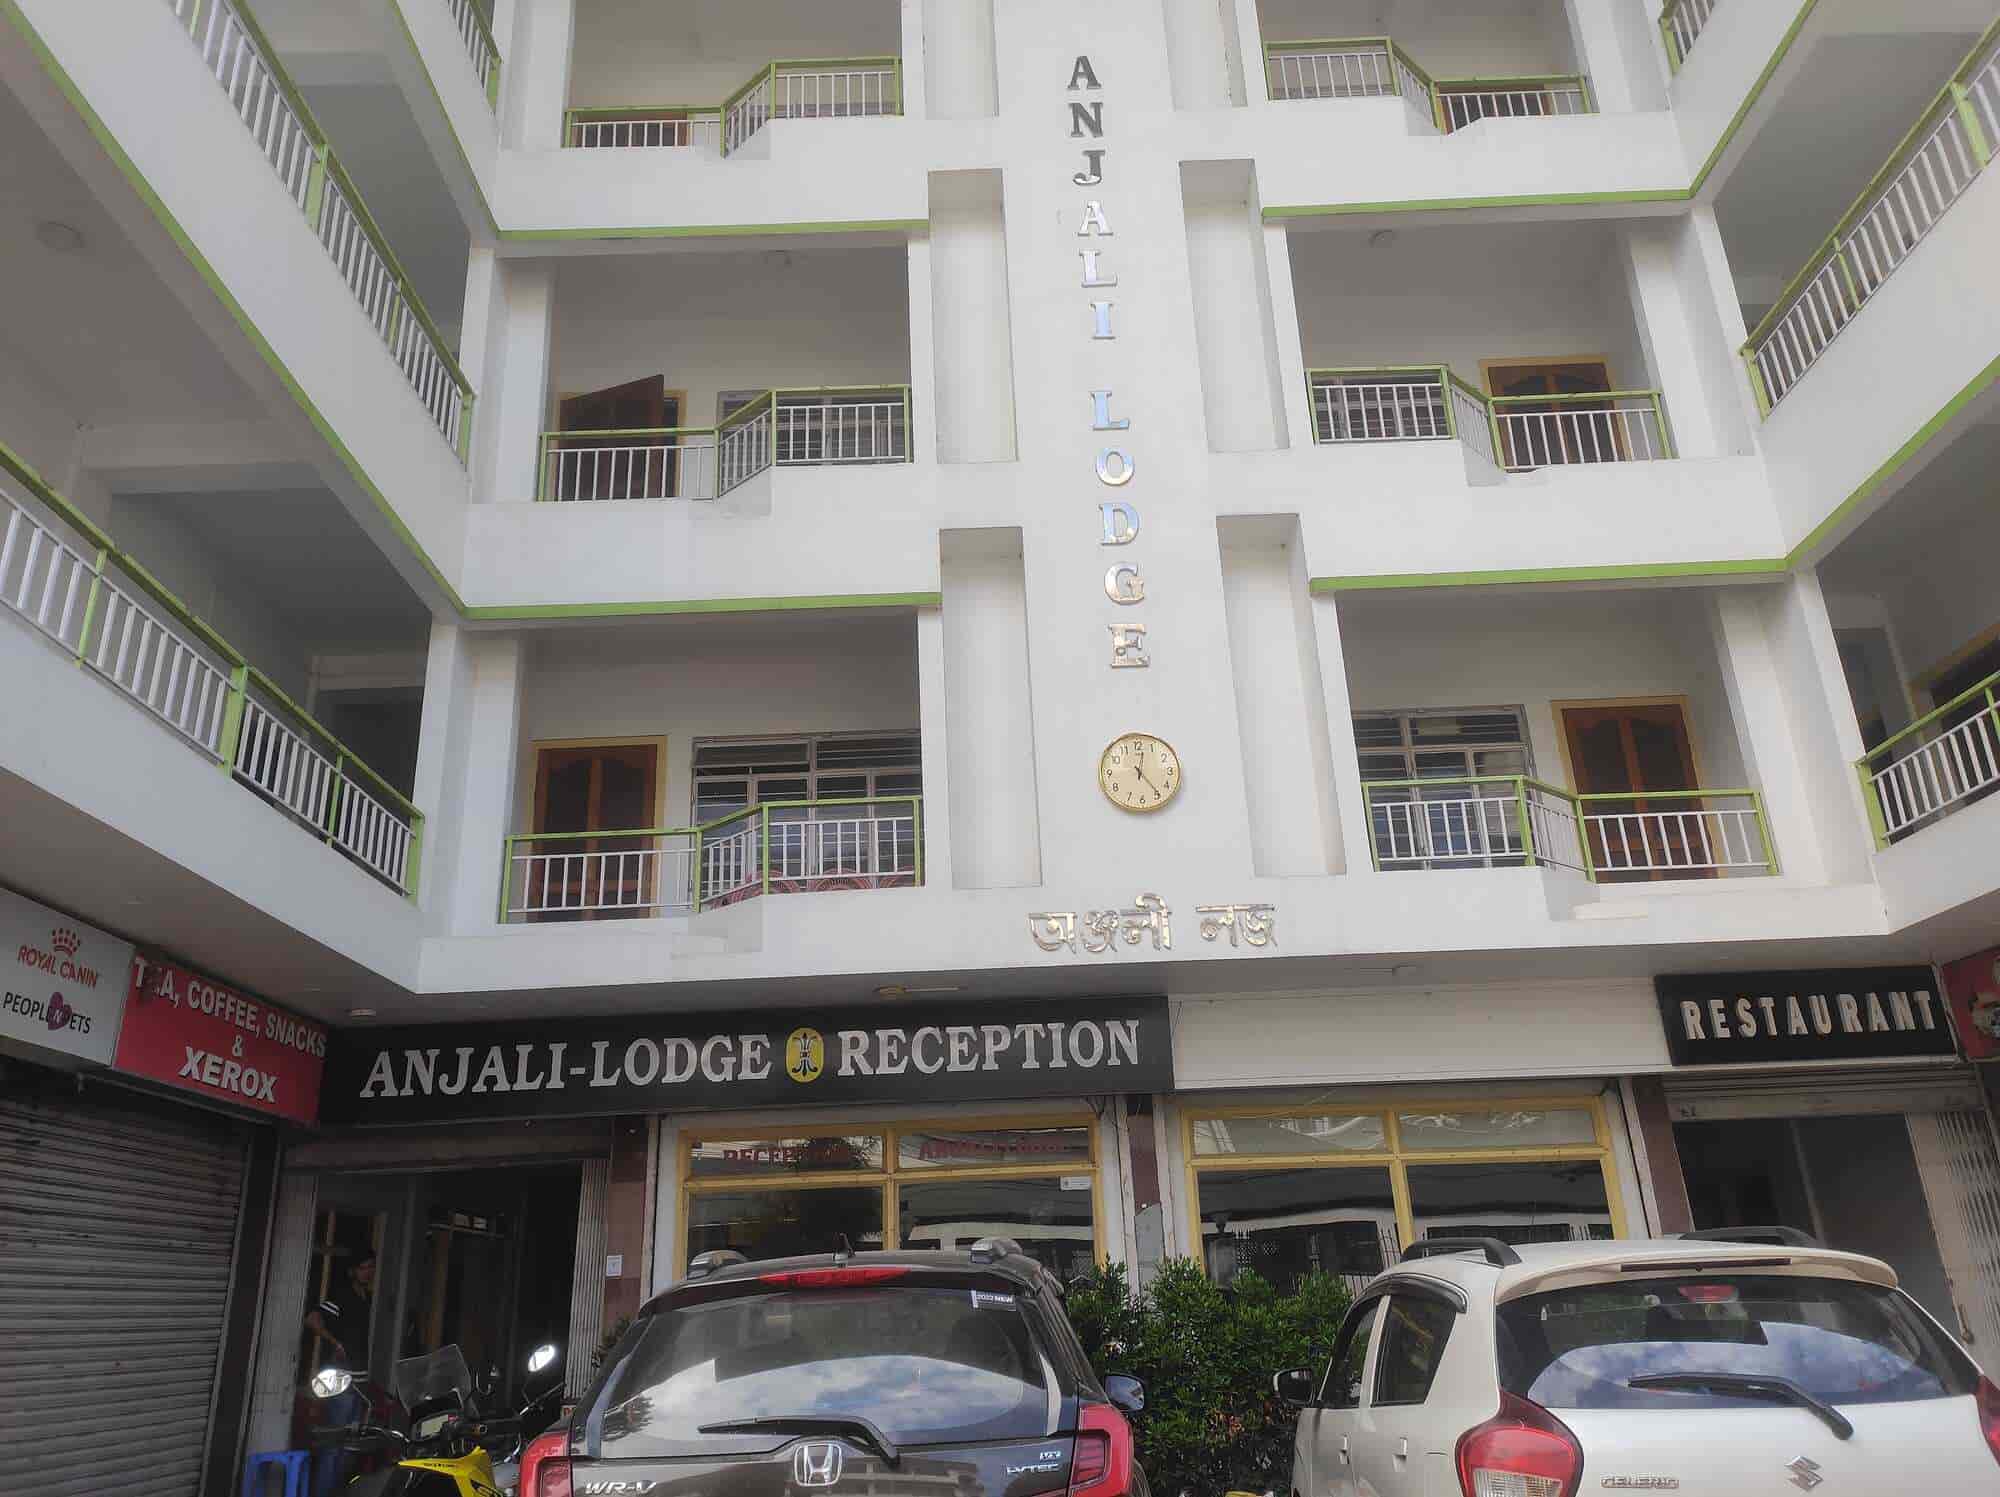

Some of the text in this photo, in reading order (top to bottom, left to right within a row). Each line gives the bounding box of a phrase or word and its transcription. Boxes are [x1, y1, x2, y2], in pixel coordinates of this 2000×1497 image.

[1067, 55, 1151, 668] ANJALI LODGE
[17, 944, 98, 989] ROYAL CANIN
[134, 956, 327, 1058] TA, COFFEE, SNACKS
[1679, 990, 1935, 1041] RESTAURANT
[232, 1035, 243, 1057] &
[359, 1018, 1141, 1098] ANJALI-LODGE RECEPTION
[178, 1045, 279, 1103] XEROX
[584, 1481, 657, 1495] WR-V
